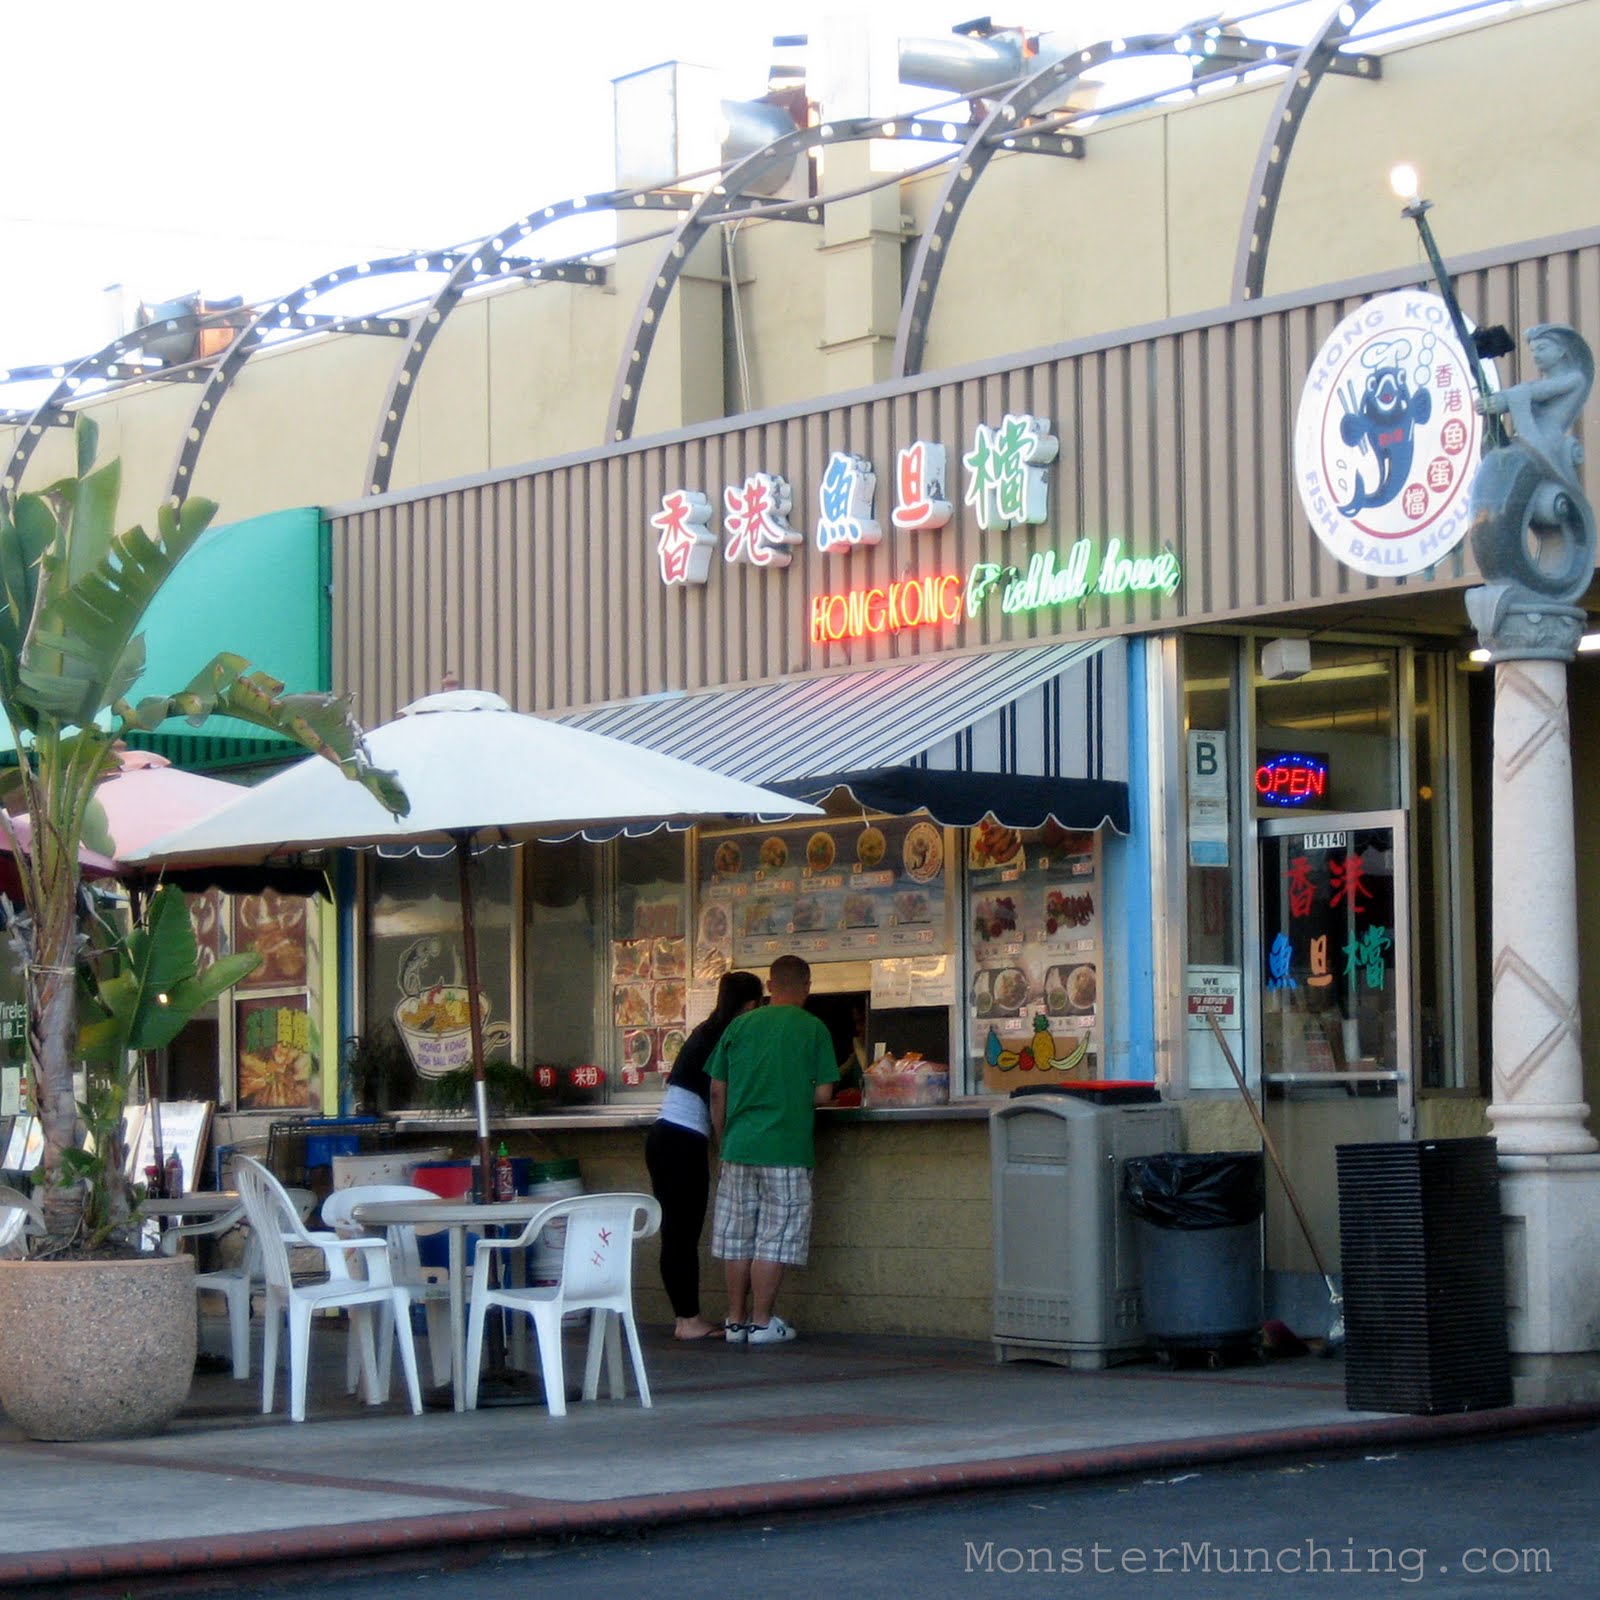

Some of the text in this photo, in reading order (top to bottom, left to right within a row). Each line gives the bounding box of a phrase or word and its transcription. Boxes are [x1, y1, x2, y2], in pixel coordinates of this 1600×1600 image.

[1312, 311, 1385, 393] HONG
[1305, 471, 1340, 537] FISH
[1348, 538, 1409, 565] BALL
[1196, 742, 1218, 775] B
[1255, 766, 1326, 796] OPEN
[1202, 977, 1219, 985] WE
[574, 1066, 598, 1087] 米粉
